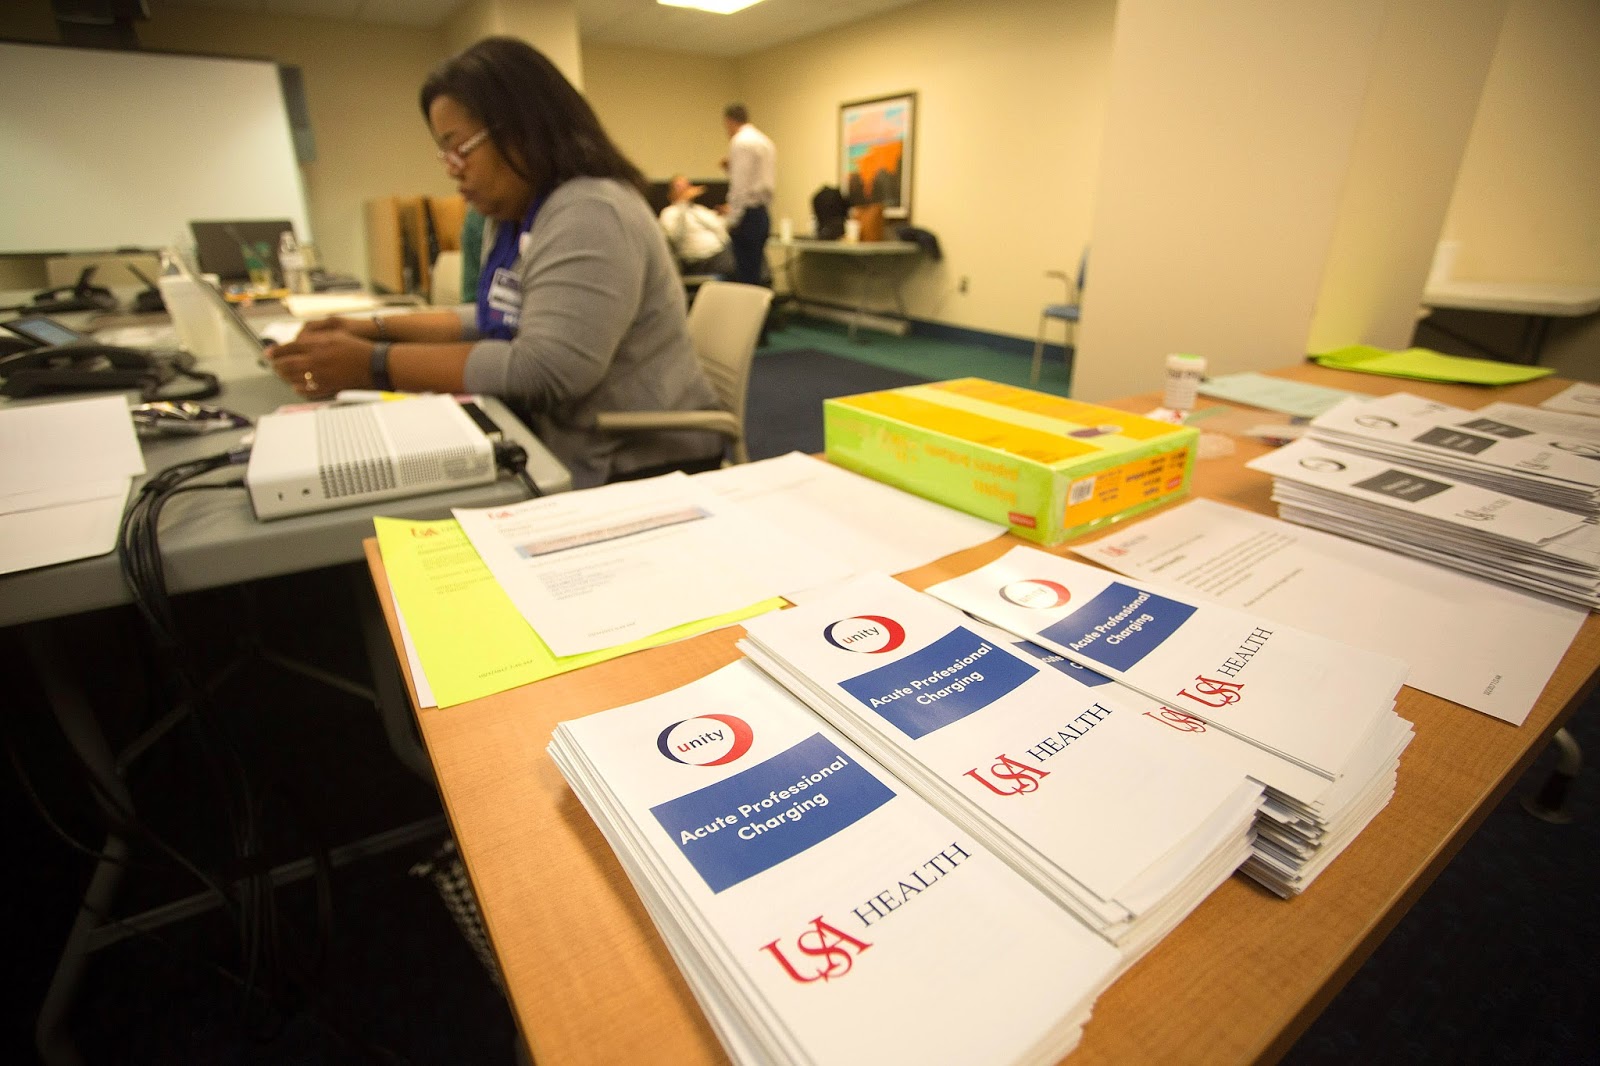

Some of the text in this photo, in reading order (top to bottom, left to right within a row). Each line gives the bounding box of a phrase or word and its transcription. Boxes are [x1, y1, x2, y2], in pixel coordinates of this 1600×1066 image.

[842, 626, 880, 644] unity
[1069, 591, 1151, 651] Acute Professional
[1106, 613, 1155, 645] Charging
[869, 642, 993, 708] Acute Professional
[916, 670, 985, 705] Charging
[1176, 674, 1245, 708] USA
[1216, 626, 1274, 678] HEALTH
[677, 729, 724, 752] unity
[962, 702, 1113, 796] USA HEALTH
[679, 755, 849, 845] Acute Professional
[737, 792, 829, 840] Charging
[759, 842, 973, 984] USA HEALTH
